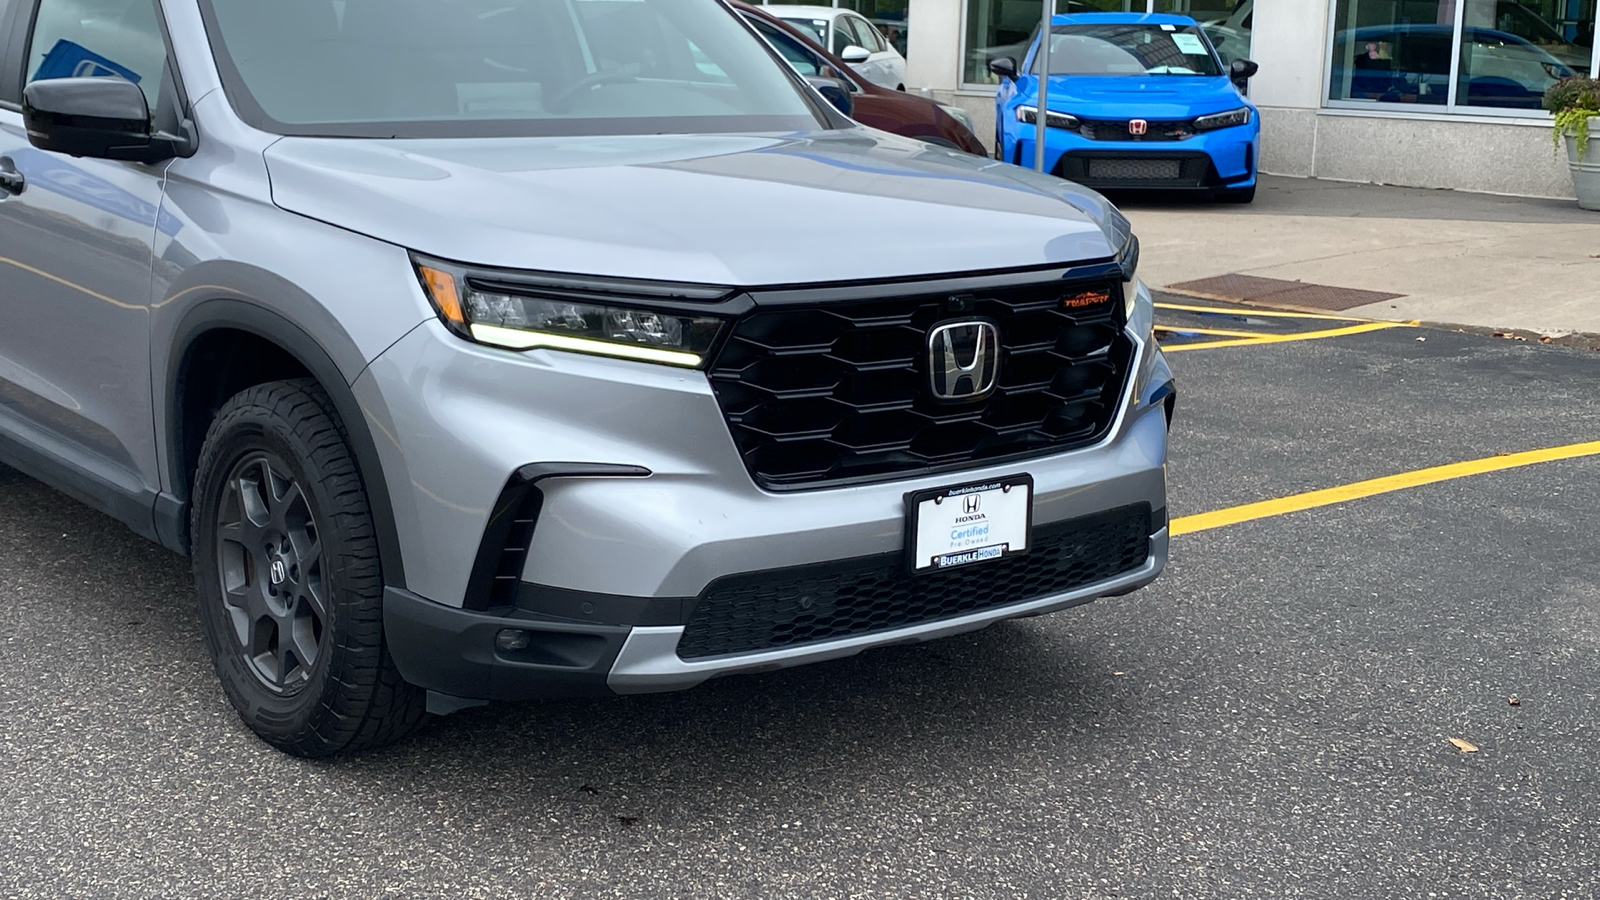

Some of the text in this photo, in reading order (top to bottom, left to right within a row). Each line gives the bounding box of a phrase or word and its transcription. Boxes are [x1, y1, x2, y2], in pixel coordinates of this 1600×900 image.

[948, 483, 1001, 496] buerklehonda.com
[955, 513, 986, 523] HONDA
[950, 524, 989, 540] Certified
